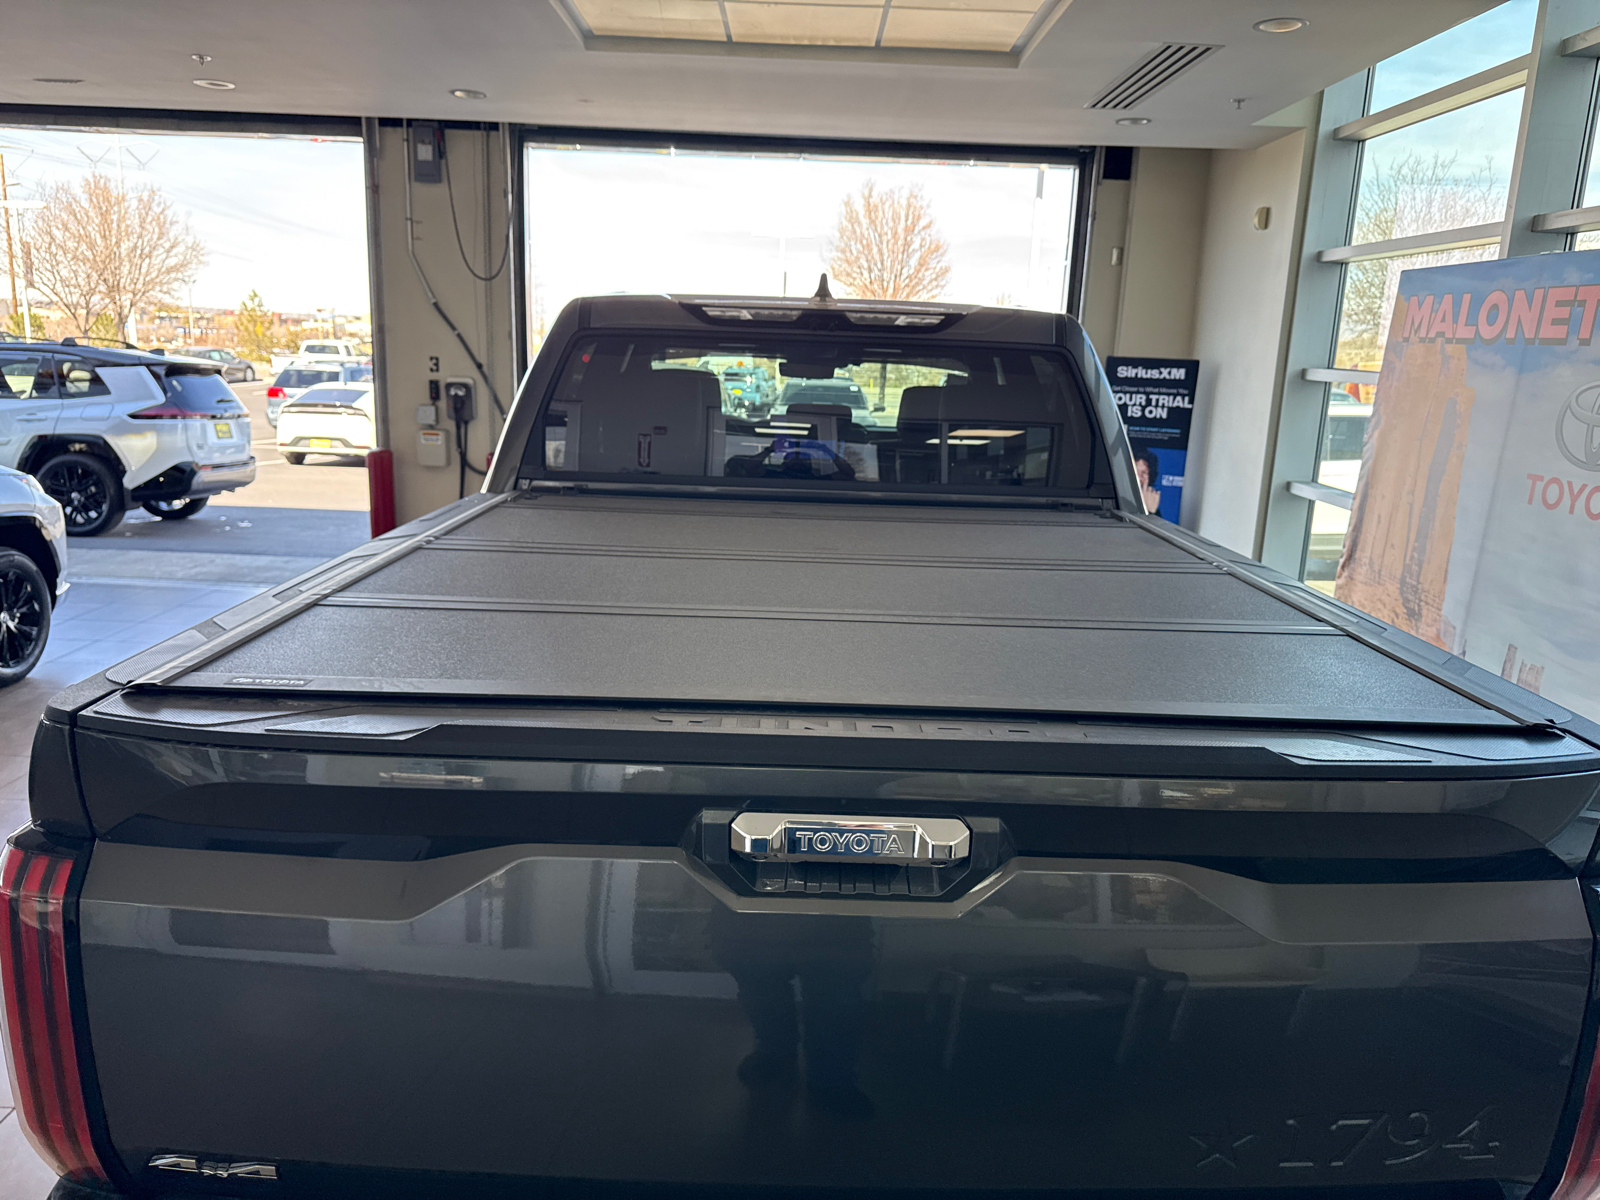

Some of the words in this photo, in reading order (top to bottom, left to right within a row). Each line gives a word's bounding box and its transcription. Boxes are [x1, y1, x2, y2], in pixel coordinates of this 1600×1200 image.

[429, 355, 440, 374] 3
[1117, 365, 1186, 380] SiriusXM
[1113, 392, 1146, 406] OUR
[1149, 394, 1193, 409] TRIAL
[1127, 405, 1142, 418] IS
[1144, 406, 1168, 419] ON
[796, 831, 904, 855] TOYOTA
[1278, 1104, 1502, 1170] 1794
